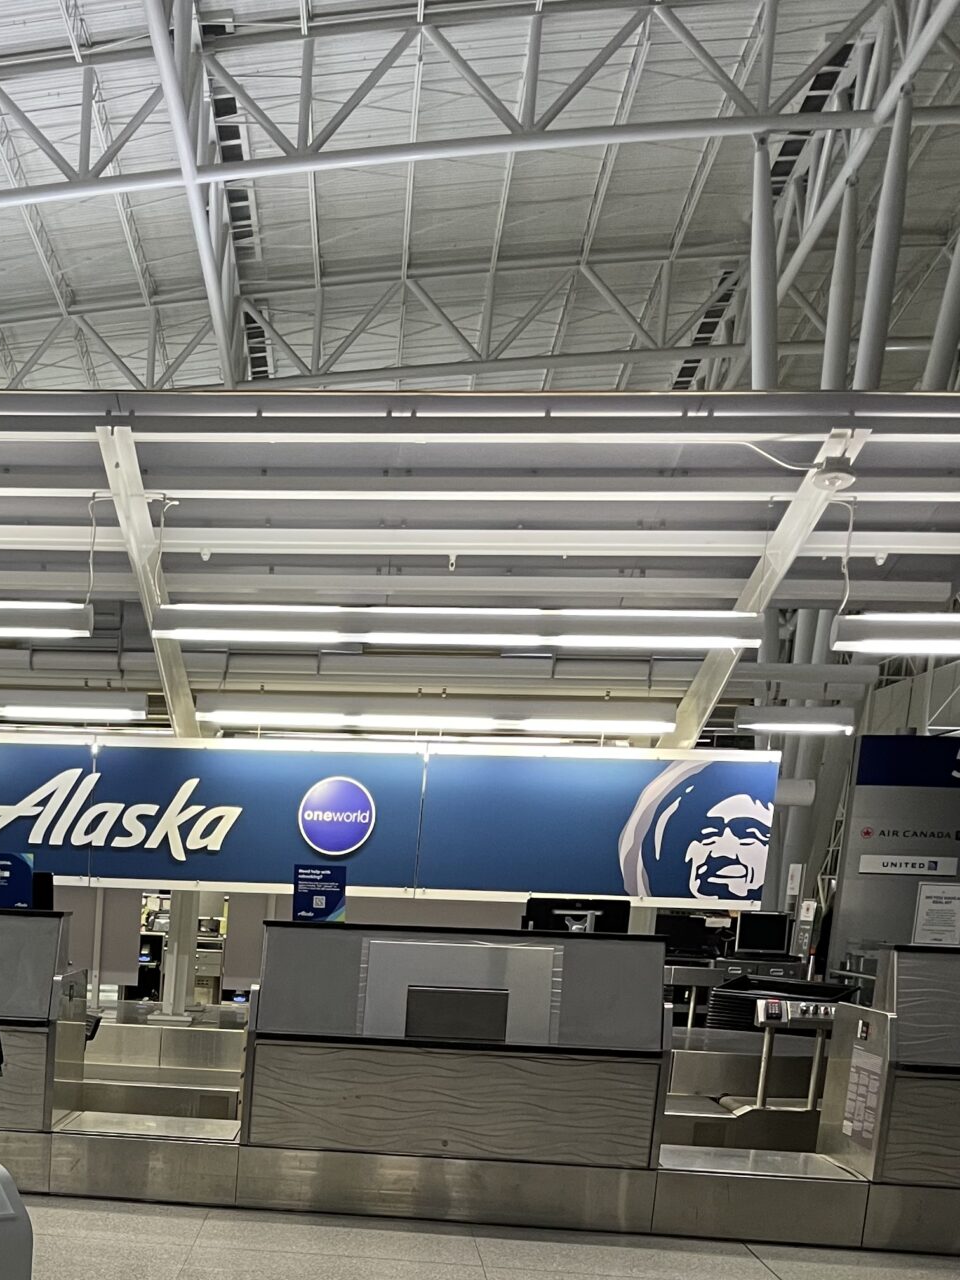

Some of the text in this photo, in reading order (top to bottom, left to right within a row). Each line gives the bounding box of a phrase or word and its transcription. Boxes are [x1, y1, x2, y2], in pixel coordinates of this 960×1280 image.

[304, 809, 370, 824] oneworld
[879, 829, 951, 839] AIR CANADA
[882, 861, 926, 869] UNITED
